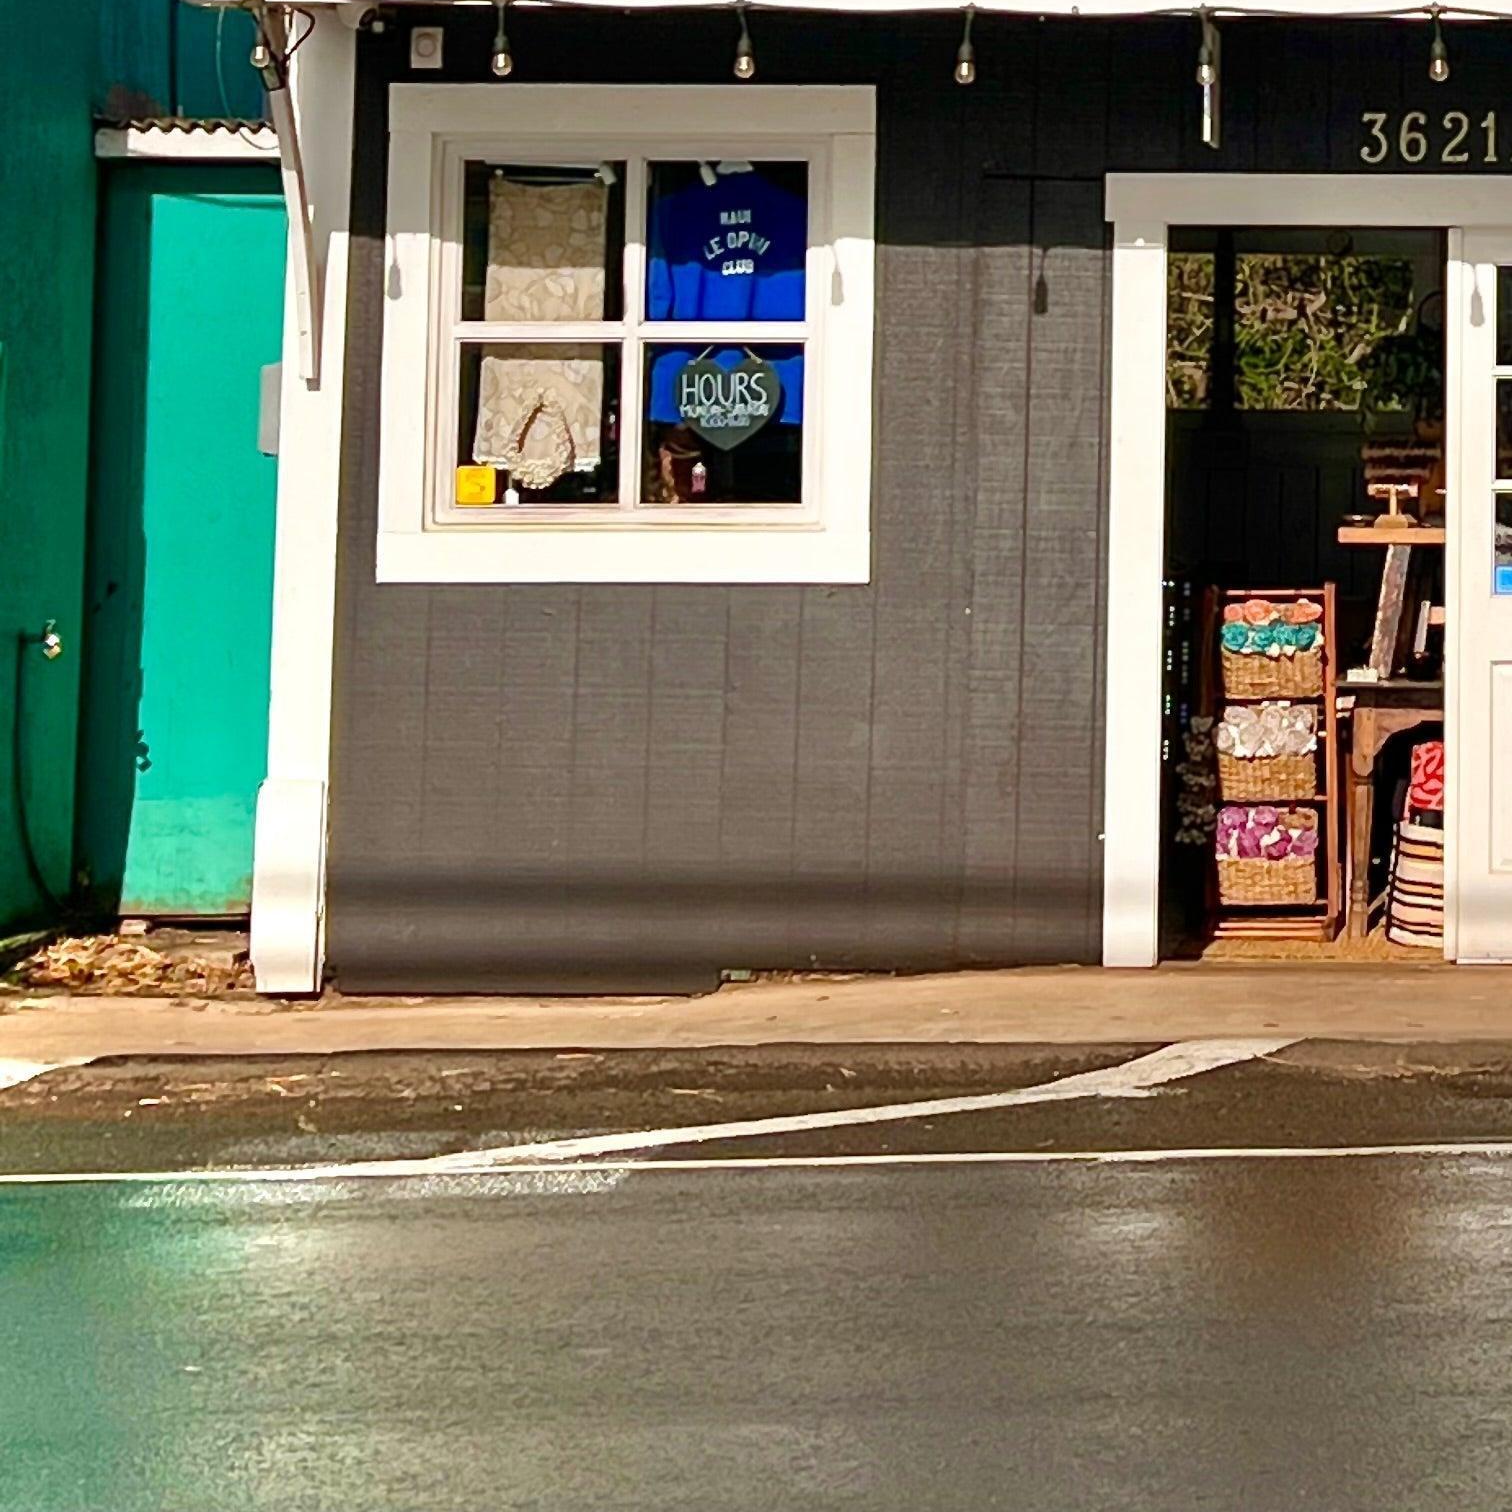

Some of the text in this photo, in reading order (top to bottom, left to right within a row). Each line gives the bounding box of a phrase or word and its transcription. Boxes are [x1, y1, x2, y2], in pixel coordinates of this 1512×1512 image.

[703, 236, 725, 261] LE
[722, 259, 754, 276] CLUB
[681, 372, 768, 406] HOURS
